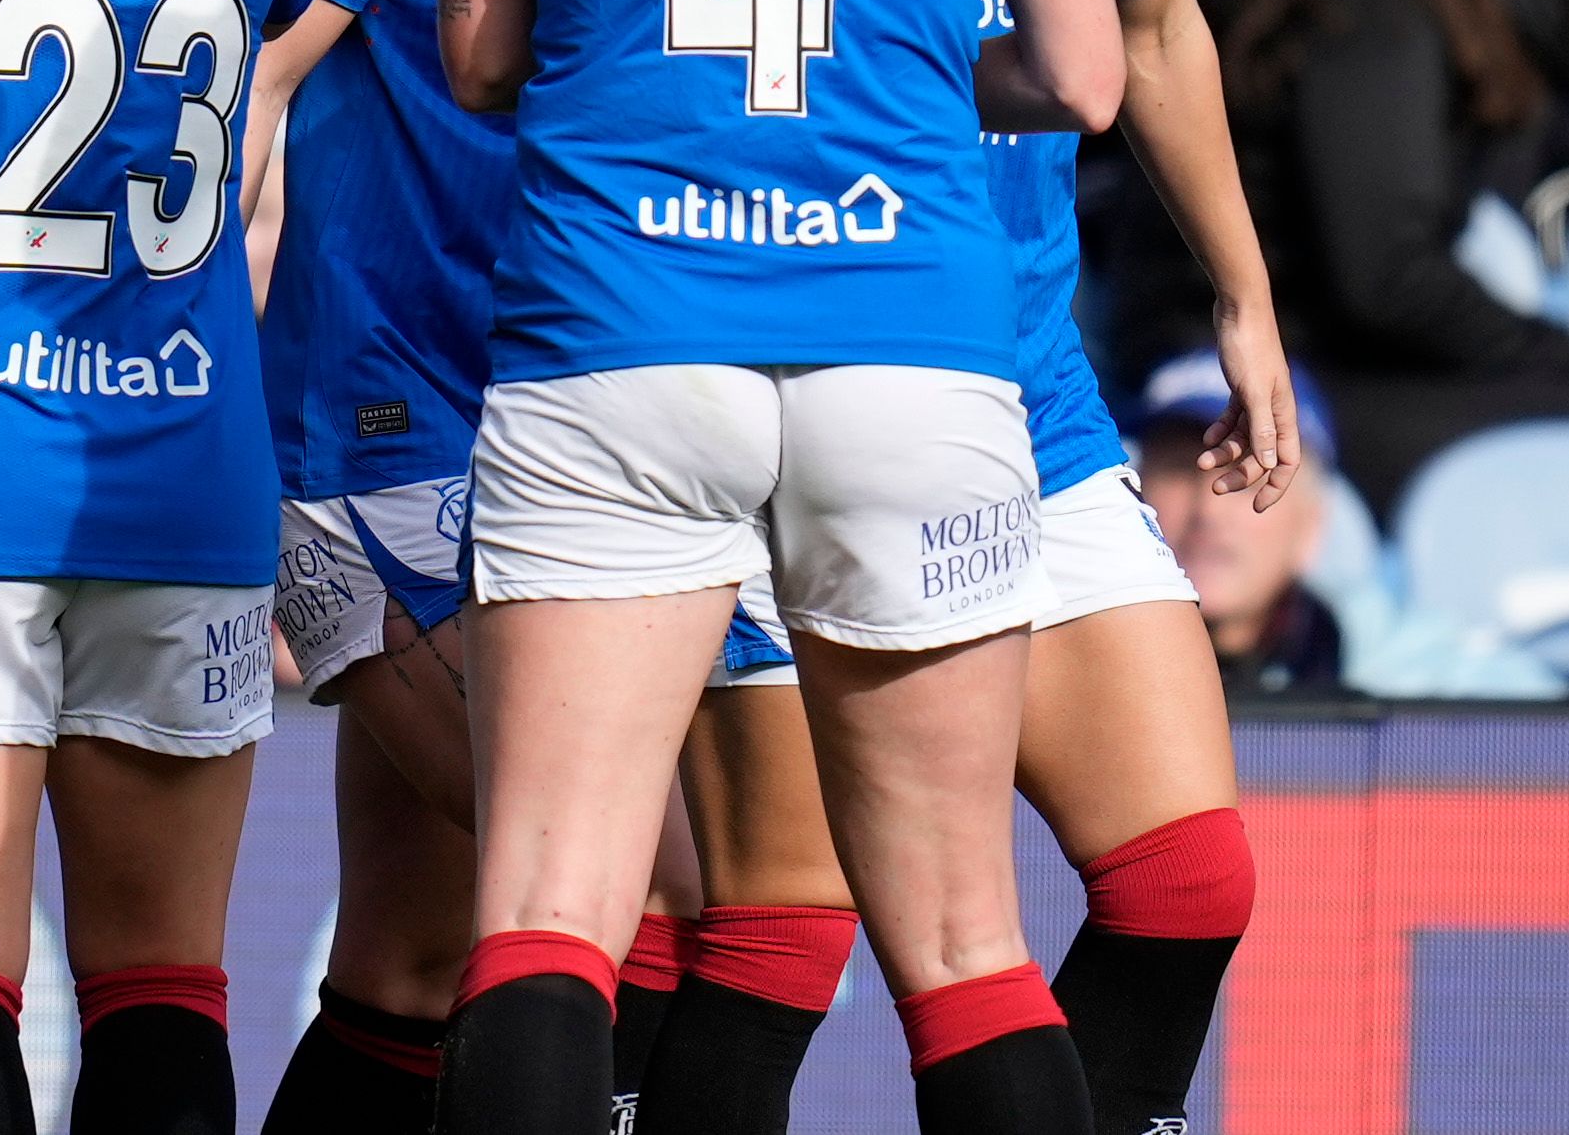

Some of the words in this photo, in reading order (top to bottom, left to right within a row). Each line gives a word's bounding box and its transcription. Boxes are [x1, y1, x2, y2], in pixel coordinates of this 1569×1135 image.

[638, 183, 839, 246] utilita
[921, 489, 1035, 556] MOLTON
[921, 529, 1034, 600] BROWN
[949, 578, 1016, 613] LONDON
[205, 597, 272, 659] MOLTO
